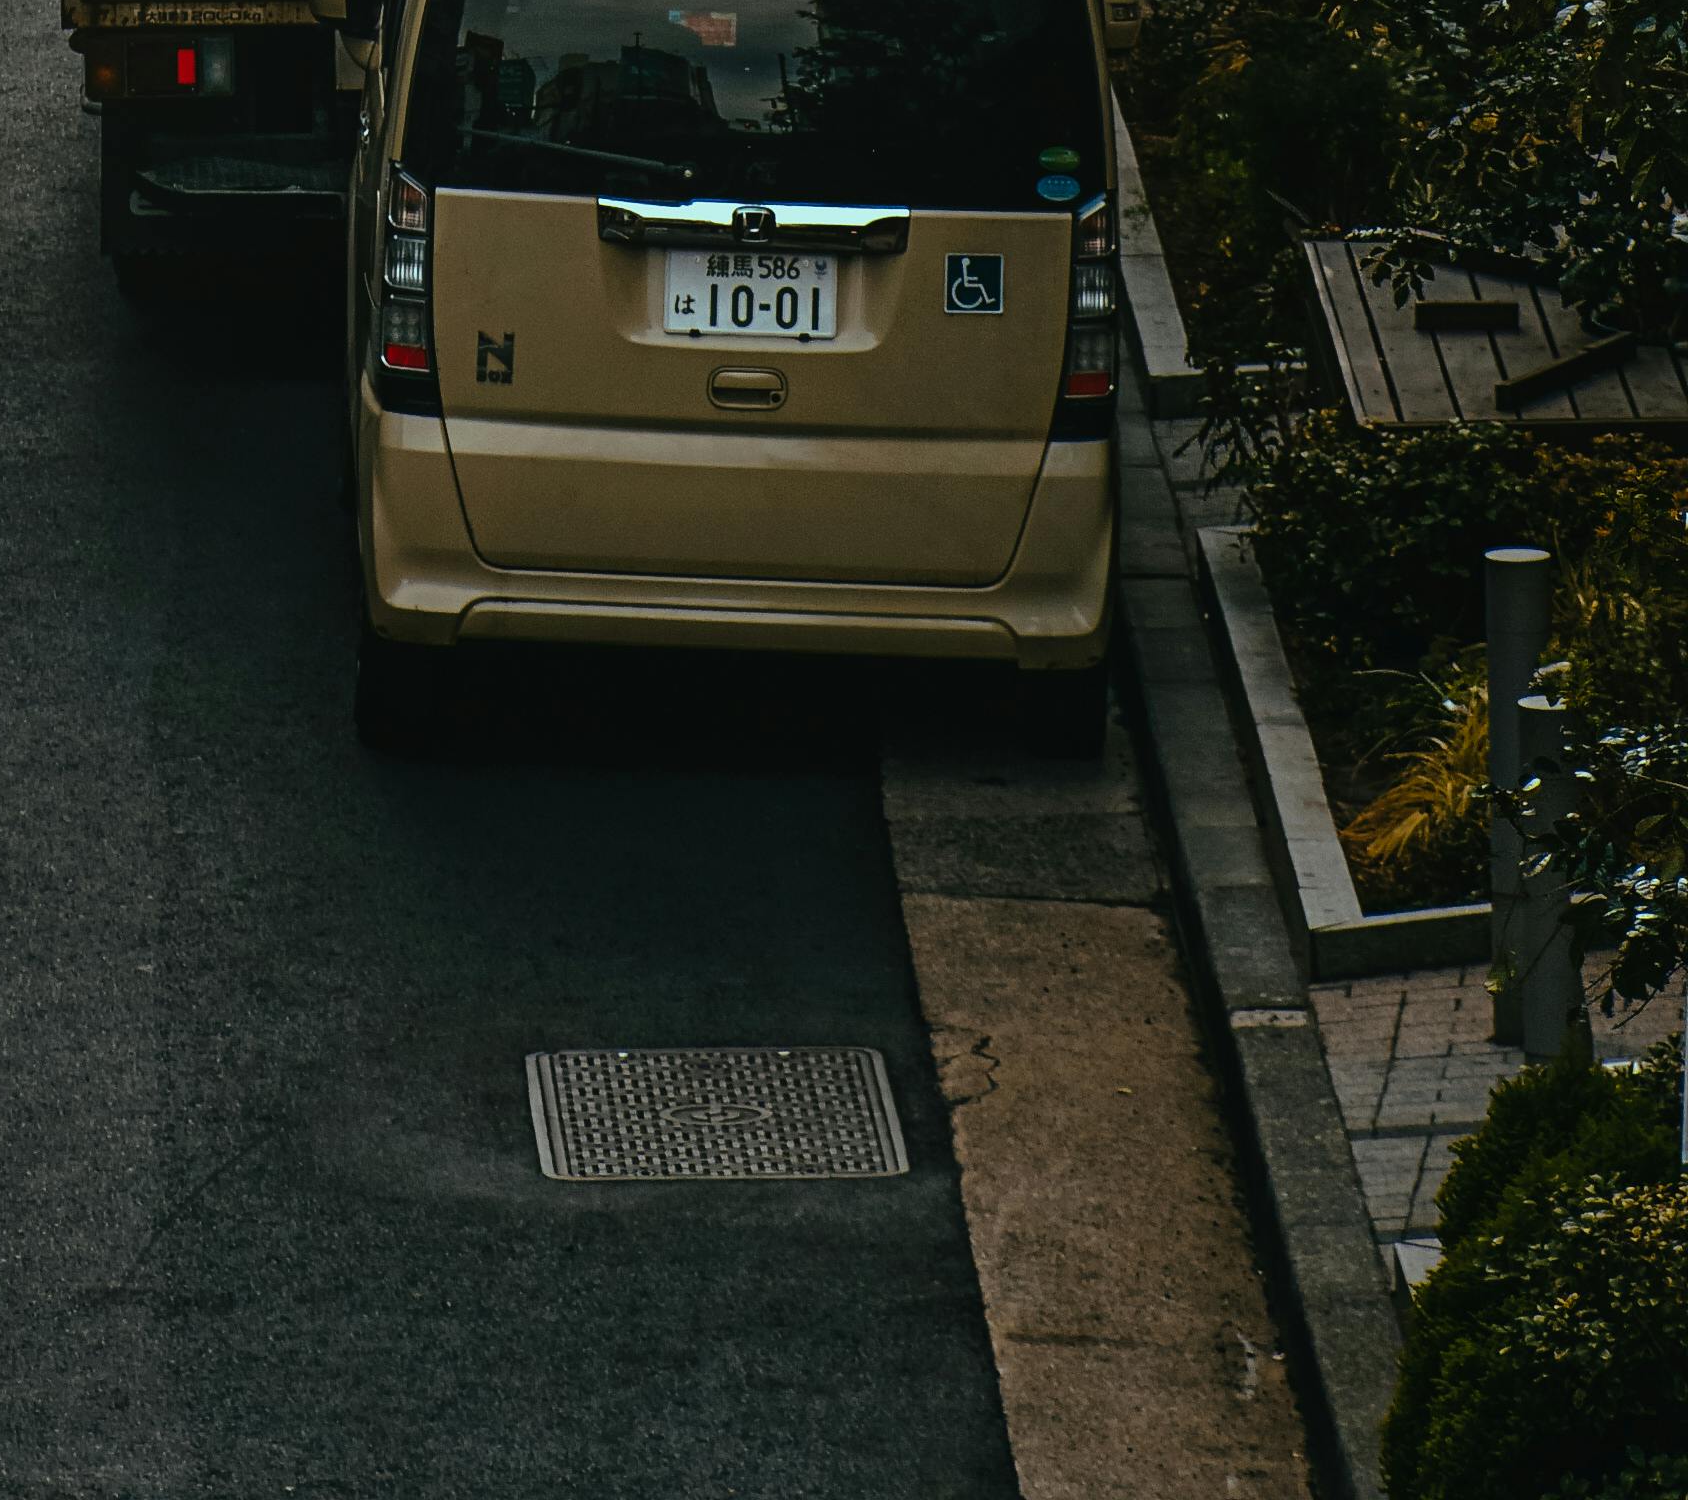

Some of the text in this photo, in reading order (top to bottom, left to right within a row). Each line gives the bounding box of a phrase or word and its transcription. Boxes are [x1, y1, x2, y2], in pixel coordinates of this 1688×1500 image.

[705, 254, 801, 280] 練馬 586
[674, 283, 821, 331] は 10-01
